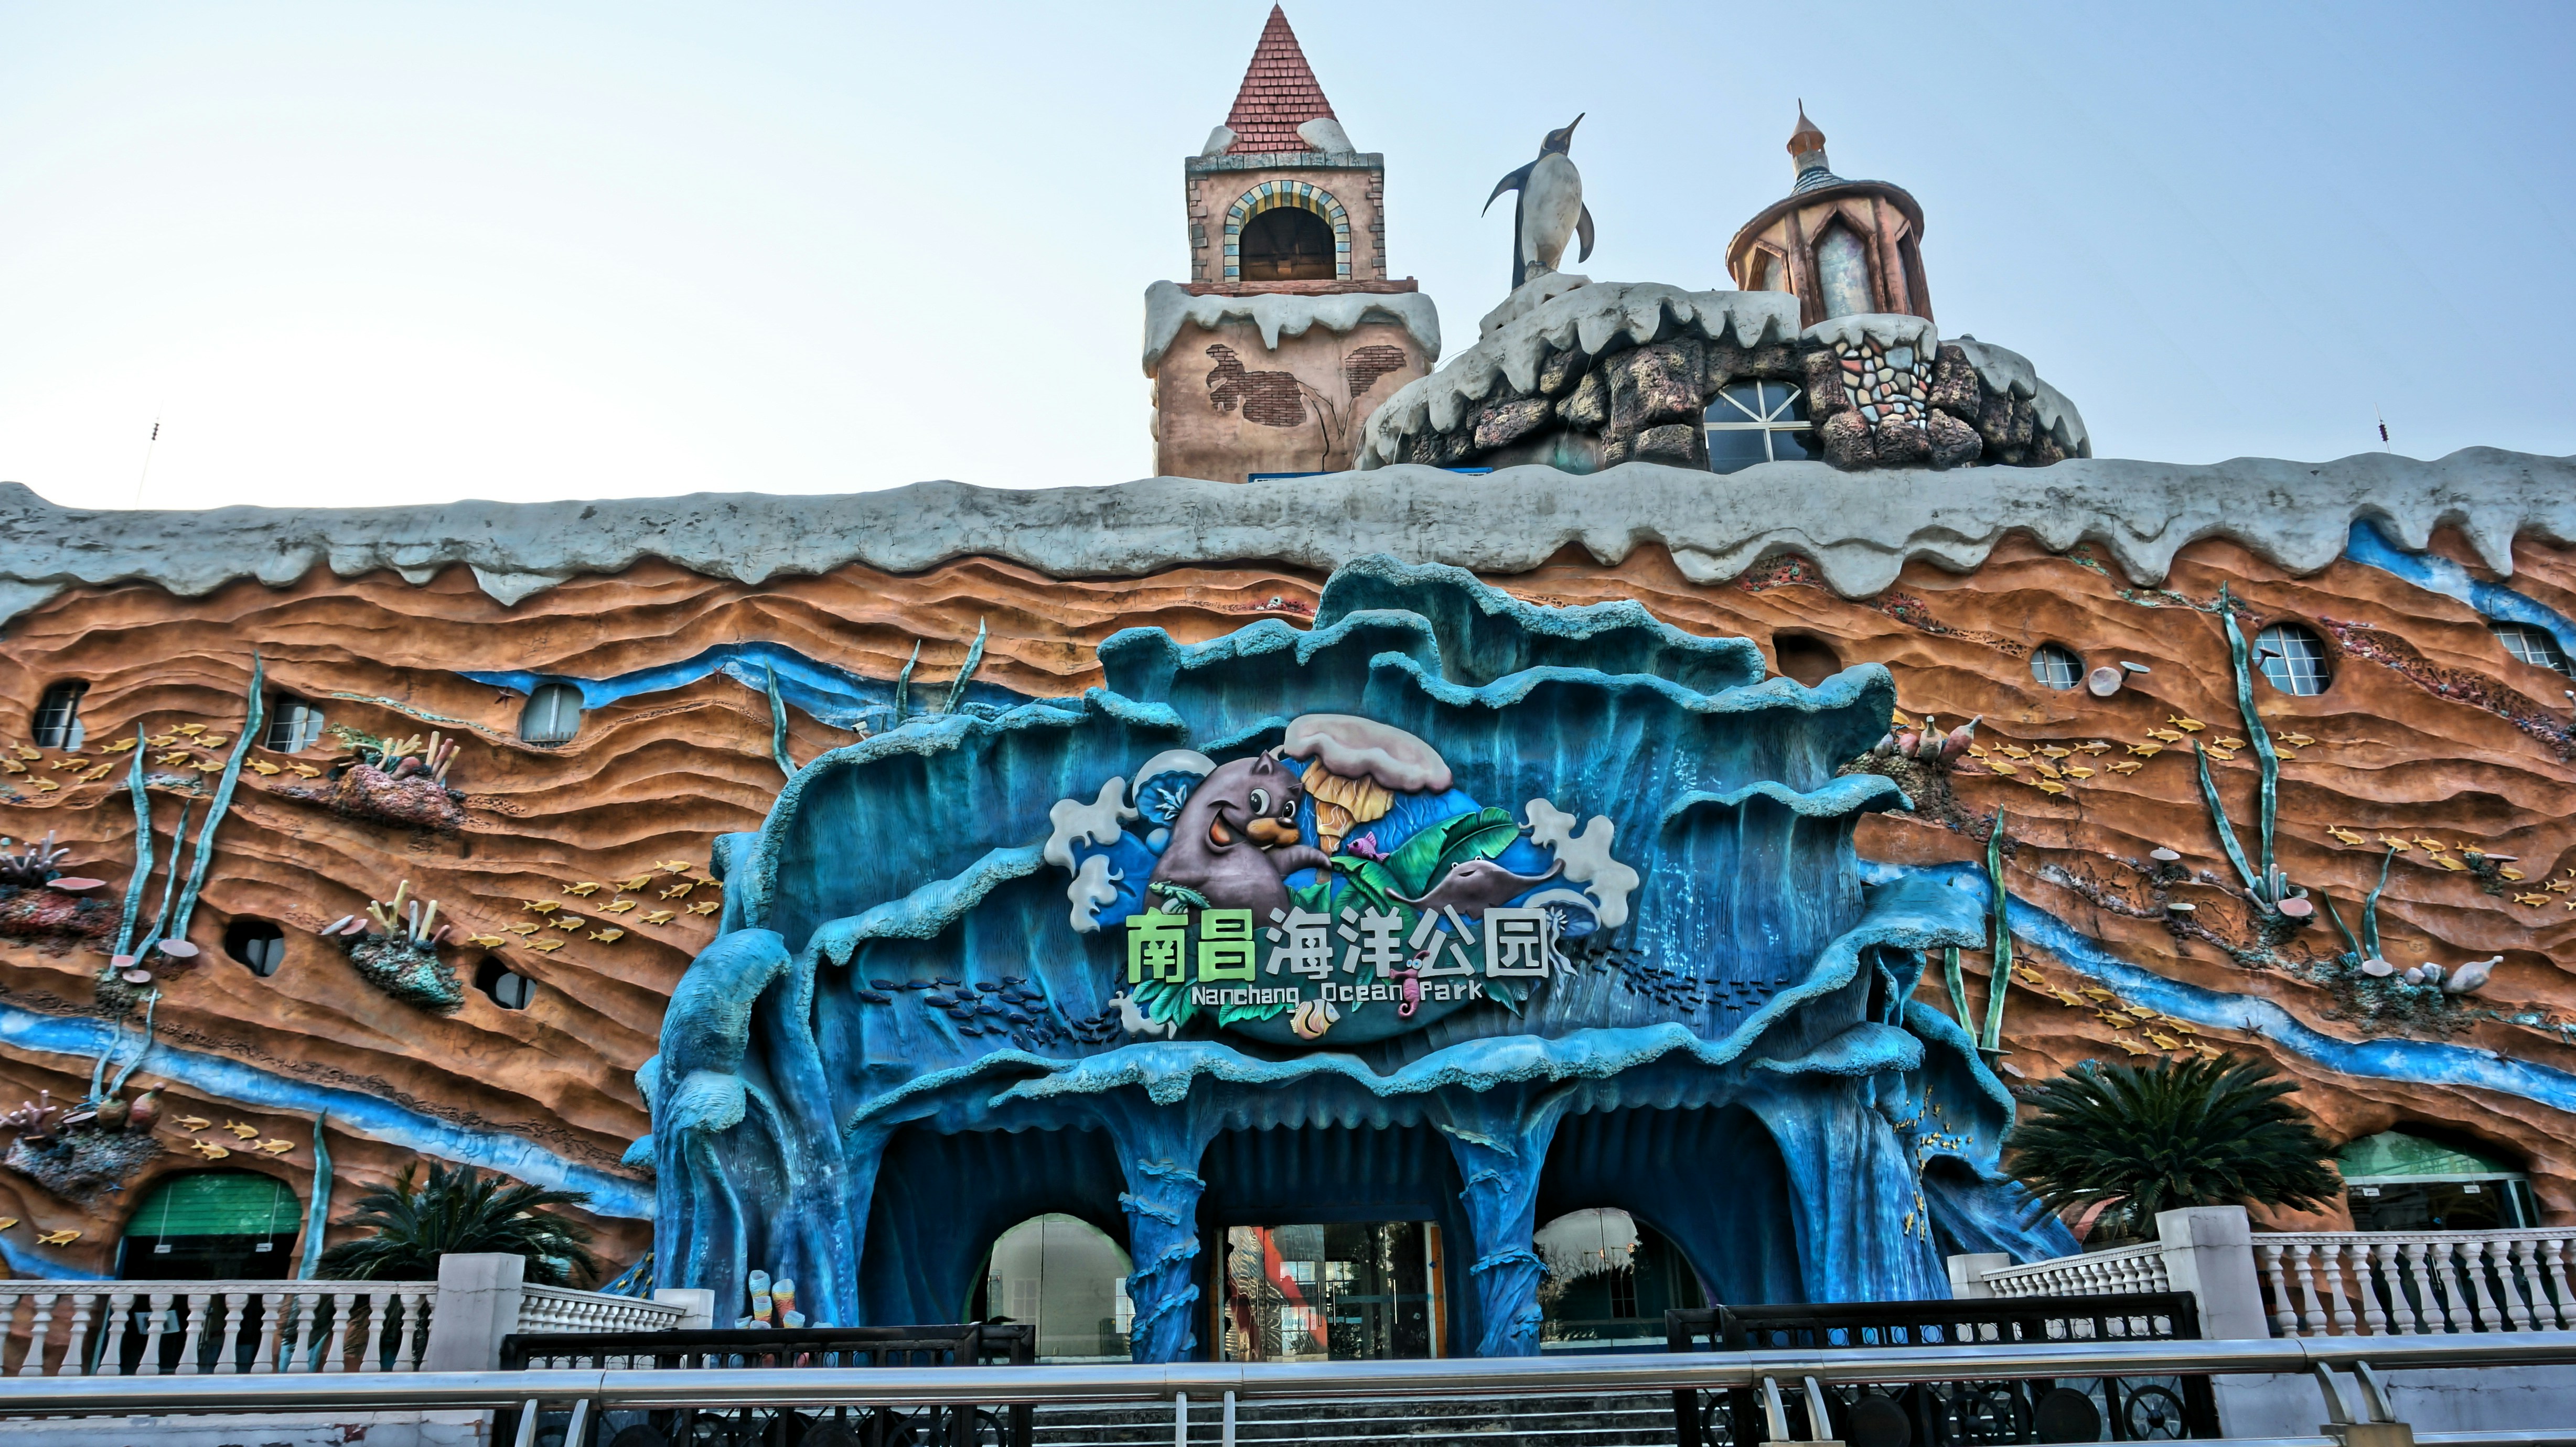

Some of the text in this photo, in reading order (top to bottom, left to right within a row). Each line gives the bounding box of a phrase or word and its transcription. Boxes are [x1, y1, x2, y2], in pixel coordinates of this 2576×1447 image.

[1126, 904, 1549, 984] 南昌海洋公园
[1192, 980, 1483, 1013] Nanchang Ocean Park
